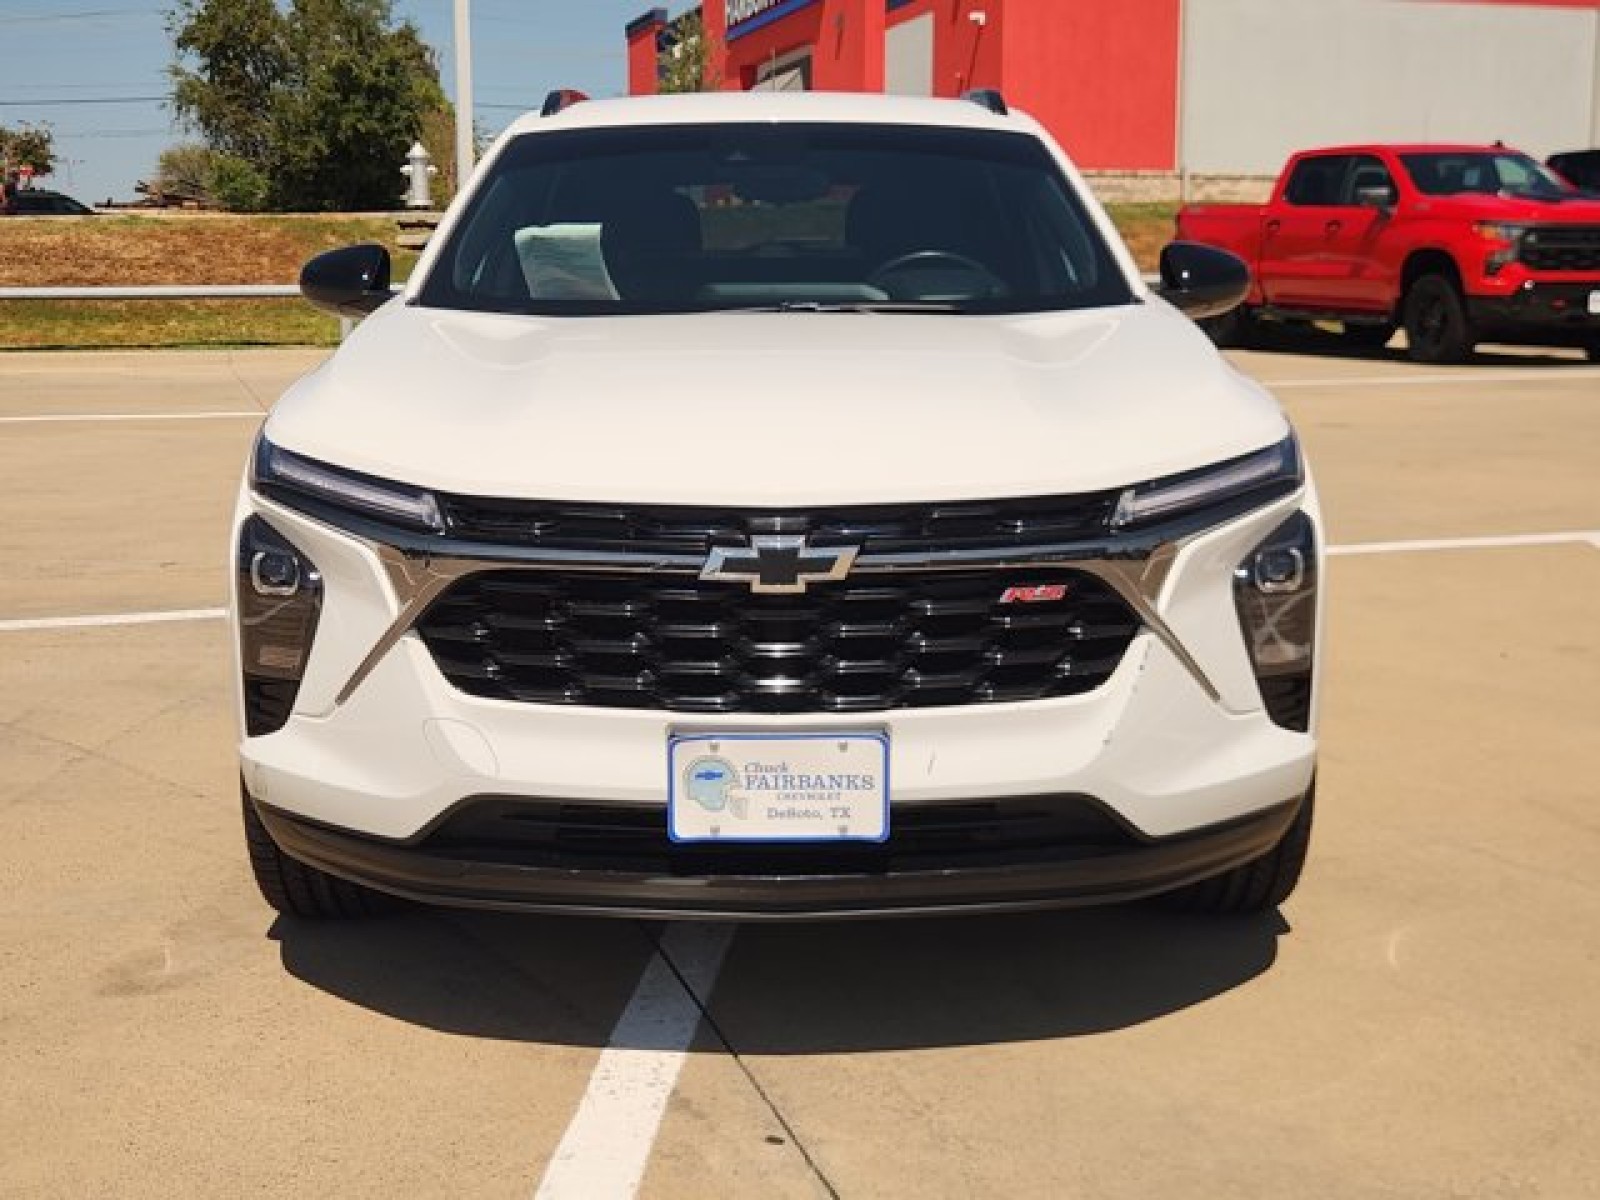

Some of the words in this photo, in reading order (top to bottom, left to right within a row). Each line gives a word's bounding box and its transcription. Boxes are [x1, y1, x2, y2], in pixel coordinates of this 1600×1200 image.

[1000, 584, 1067, 604] RS
[744, 760, 788, 773] Chuck
[745, 774, 875, 791] FAIRBANKS
[829, 806, 851, 819] TX
